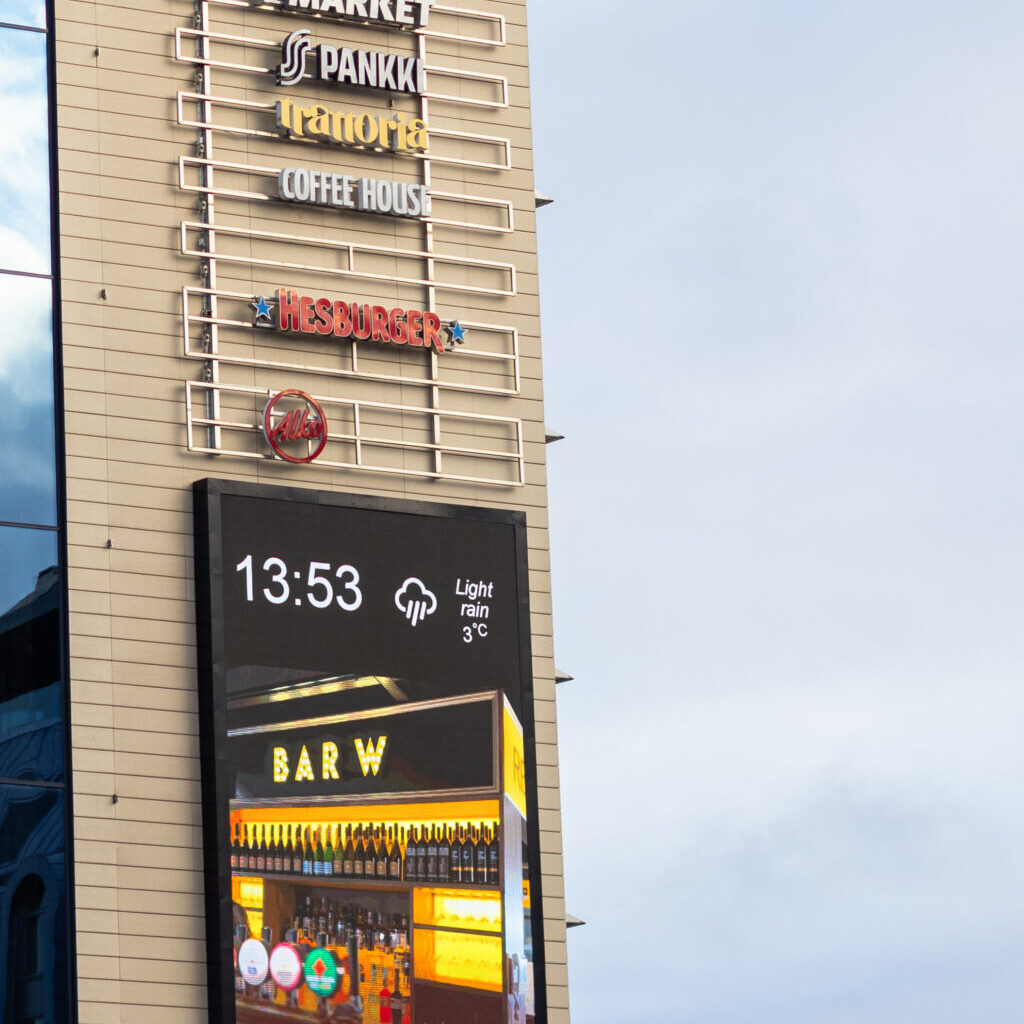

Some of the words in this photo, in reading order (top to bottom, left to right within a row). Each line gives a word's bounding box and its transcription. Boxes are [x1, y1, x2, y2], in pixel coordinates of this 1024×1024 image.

[319, 43, 425, 94] PANKKI
[277, 97, 428, 151] trattoria
[278, 166, 355, 208] COFFEE
[359, 176, 432, 217] HOUSE
[278, 288, 445, 355] HESBURGER
[270, 408, 324, 441] Alko
[235, 554, 364, 612] 13:53
[455, 578, 494, 599] Light
[460, 601, 490, 619] rain
[462, 622, 489, 643] 3°C
[273, 741, 341, 783] BAR
[354, 735, 388, 777] W
